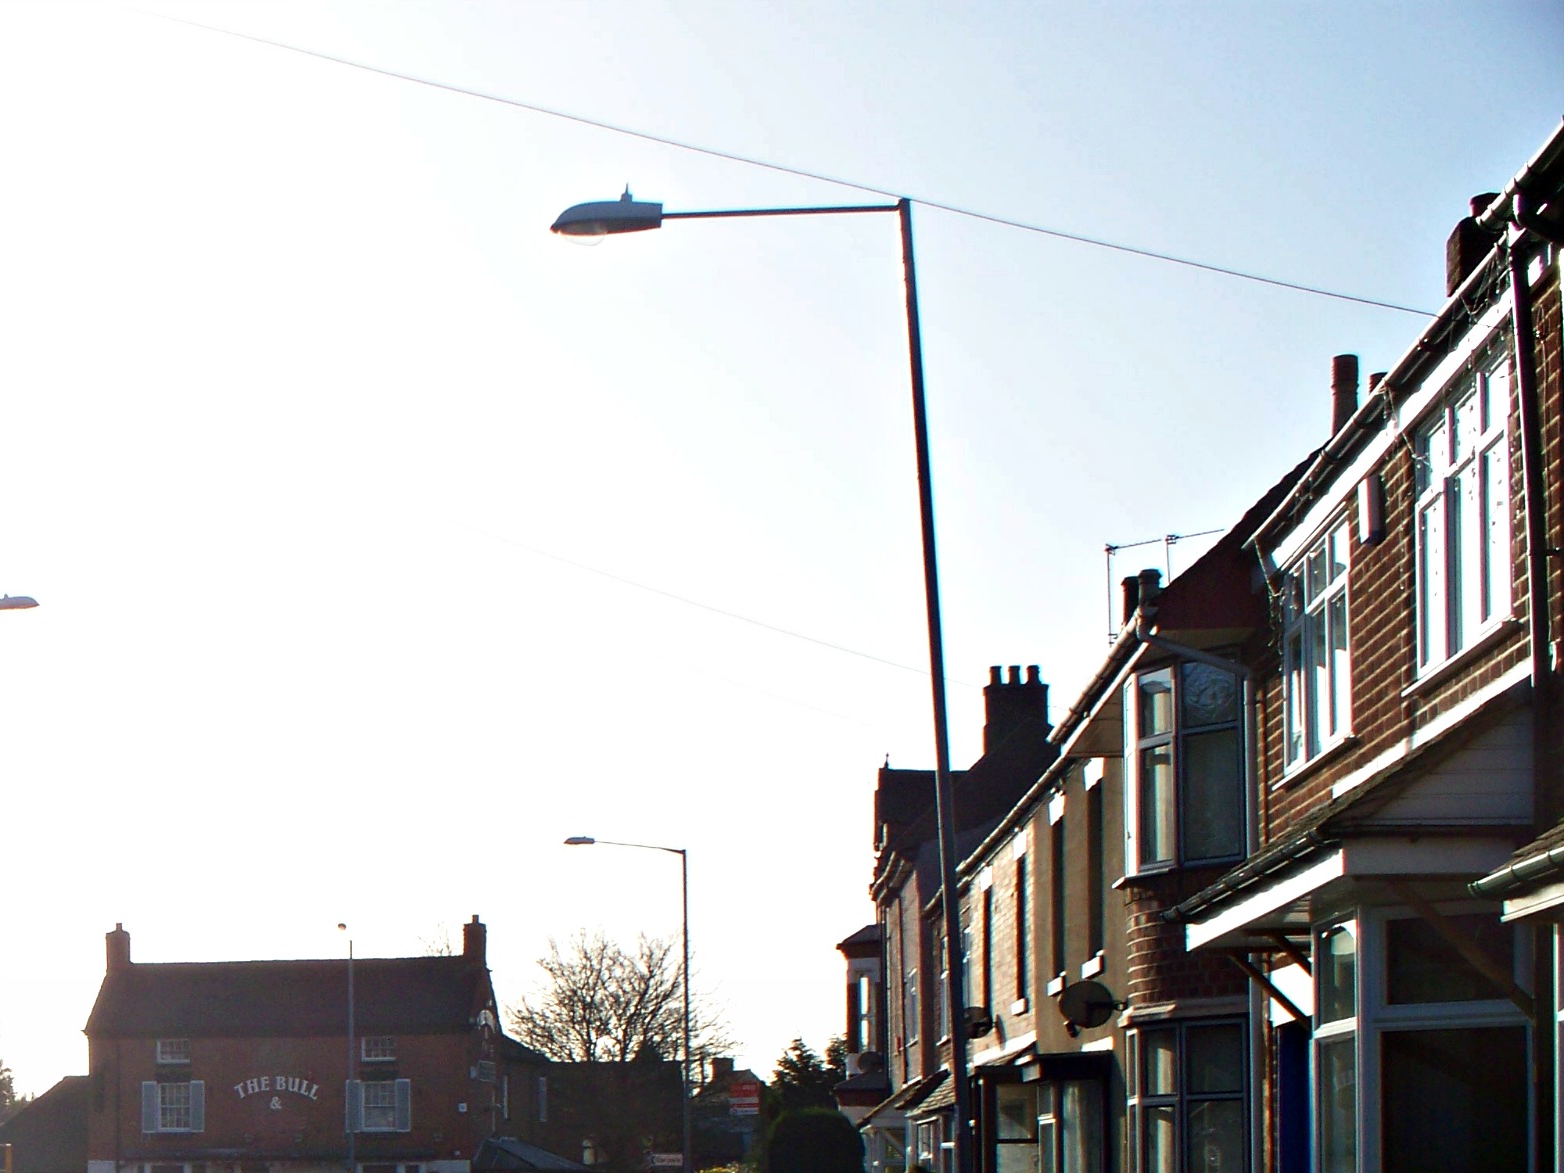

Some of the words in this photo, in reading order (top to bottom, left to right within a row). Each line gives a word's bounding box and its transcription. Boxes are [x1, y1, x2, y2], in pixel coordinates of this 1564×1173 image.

[233, 1076, 270, 1099] THE
[275, 1076, 320, 1100] BULL
[270, 1096, 282, 1109] &
